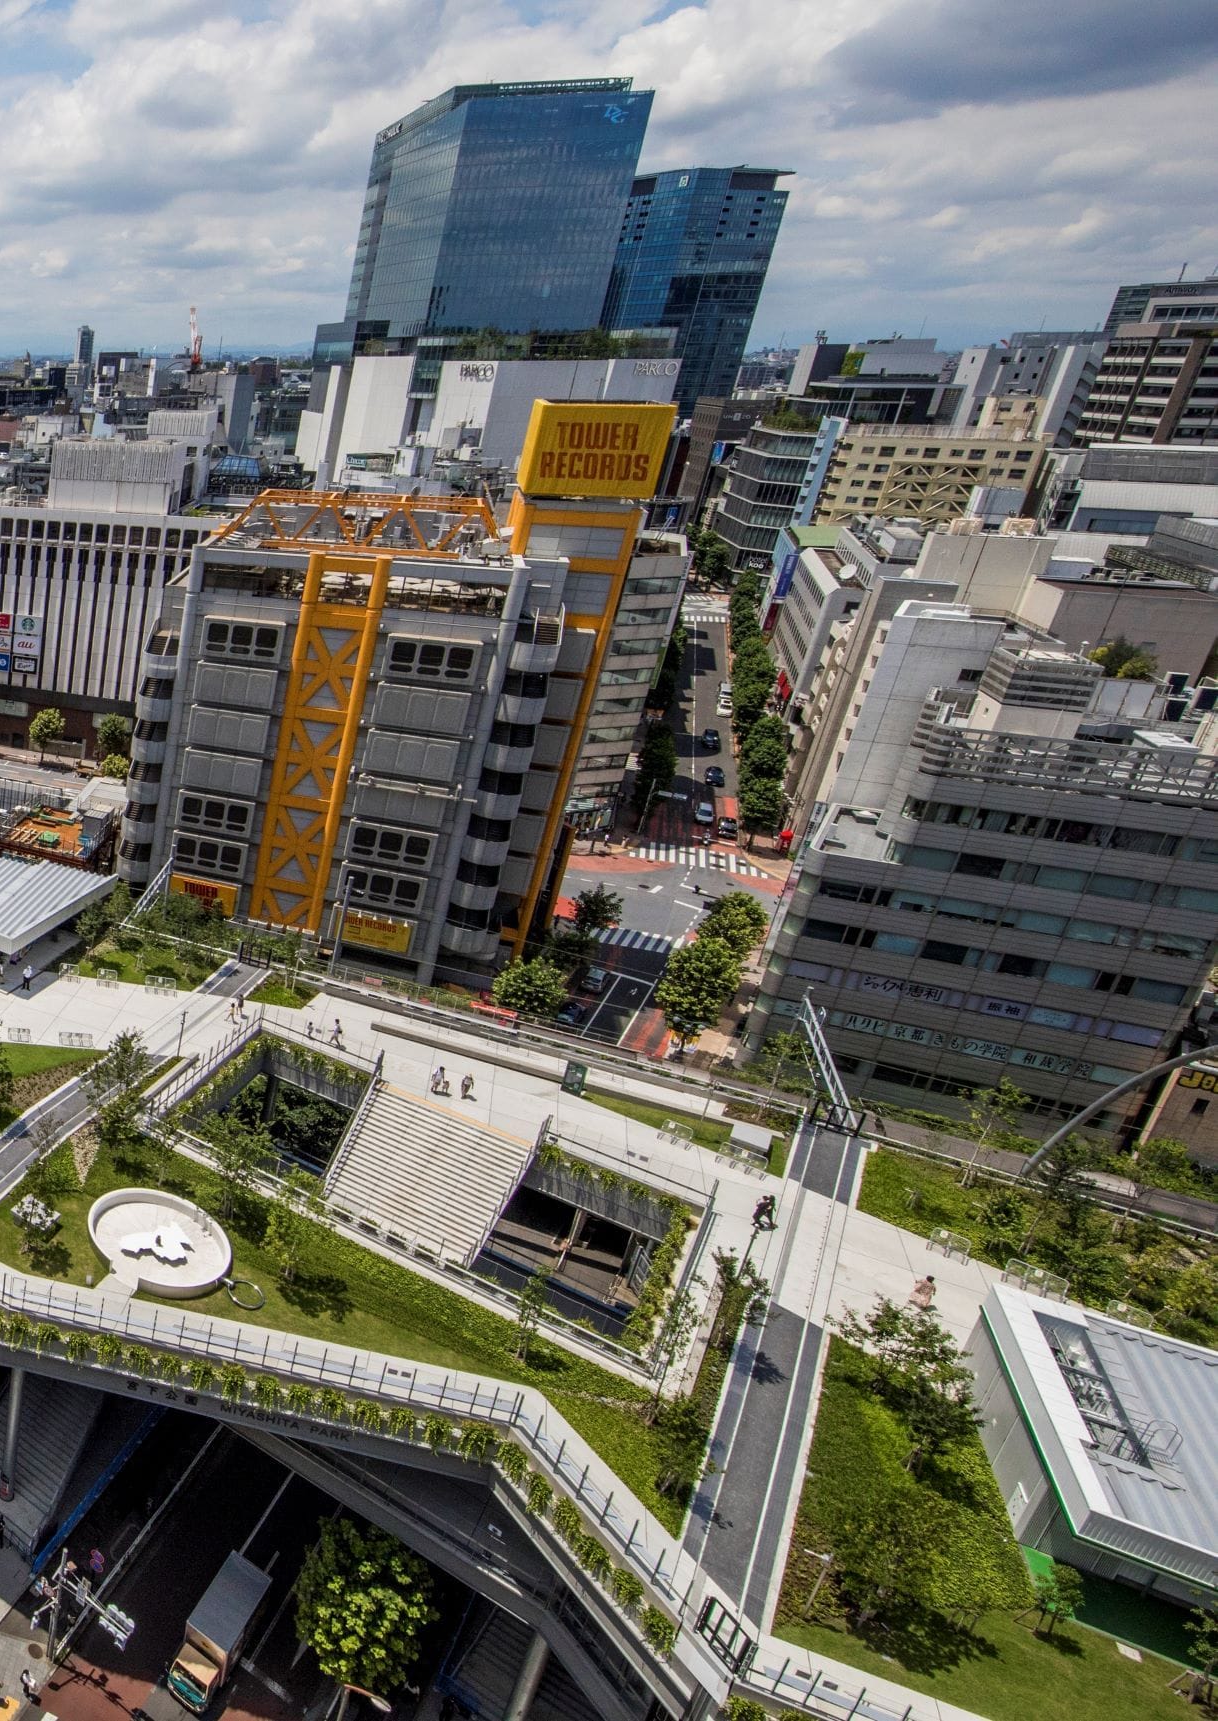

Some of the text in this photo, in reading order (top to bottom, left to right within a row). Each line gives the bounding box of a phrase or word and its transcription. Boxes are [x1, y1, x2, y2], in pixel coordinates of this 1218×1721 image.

[461, 364, 494, 379] PARCO
[634, 362, 679, 377] PARCO
[557, 422, 639, 450] TOWER
[540, 451, 650, 482] RECORDS
[17, 641, 35, 650] au
[184, 881, 218, 898] TOWER
[365, 918, 398, 934] RECORDS
[864, 976, 943, 1002] ジョイフル恵利
[987, 1001, 1021, 1017] 振袖
[894, 1026, 1007, 1058] 京都きもの学院
[126, 1380, 198, 1406] 宮下公園
[220, 1403, 349, 1442] MIYASHITA PARK
